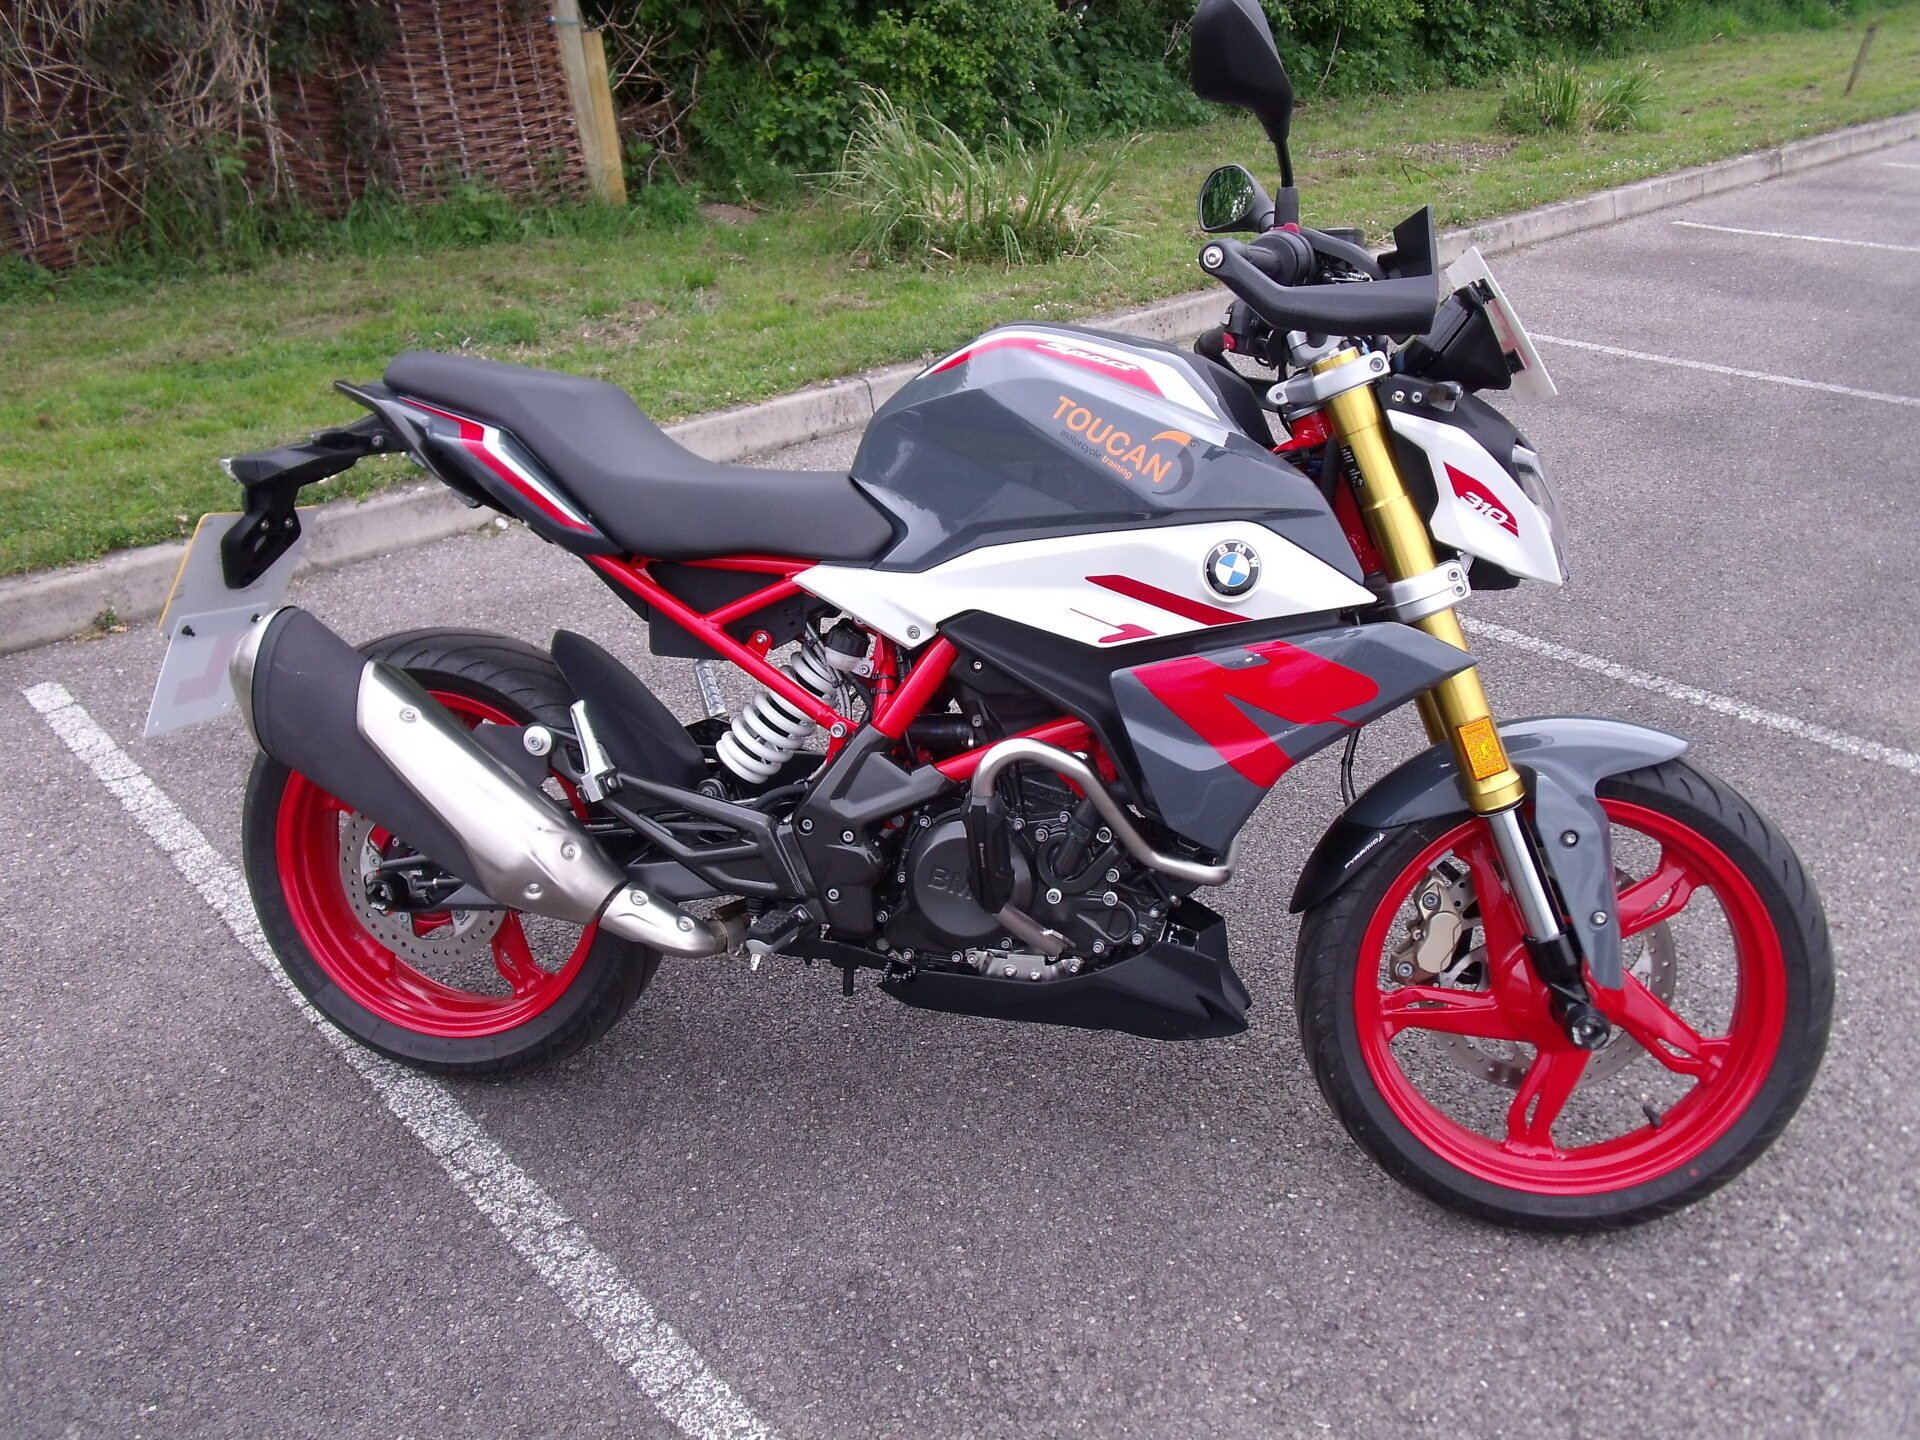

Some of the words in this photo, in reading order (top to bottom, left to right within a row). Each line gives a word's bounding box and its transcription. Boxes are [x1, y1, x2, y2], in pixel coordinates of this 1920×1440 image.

[1053, 395, 1173, 483] TOUCAN
[1060, 429, 1102, 458] motorcycle
[1102, 455, 1133, 480] training
[1459, 491, 1509, 525] 310
[1217, 543, 1260, 568] BMW
[1344, 837, 1379, 870] PYRAMID
[928, 865, 972, 899] BM
